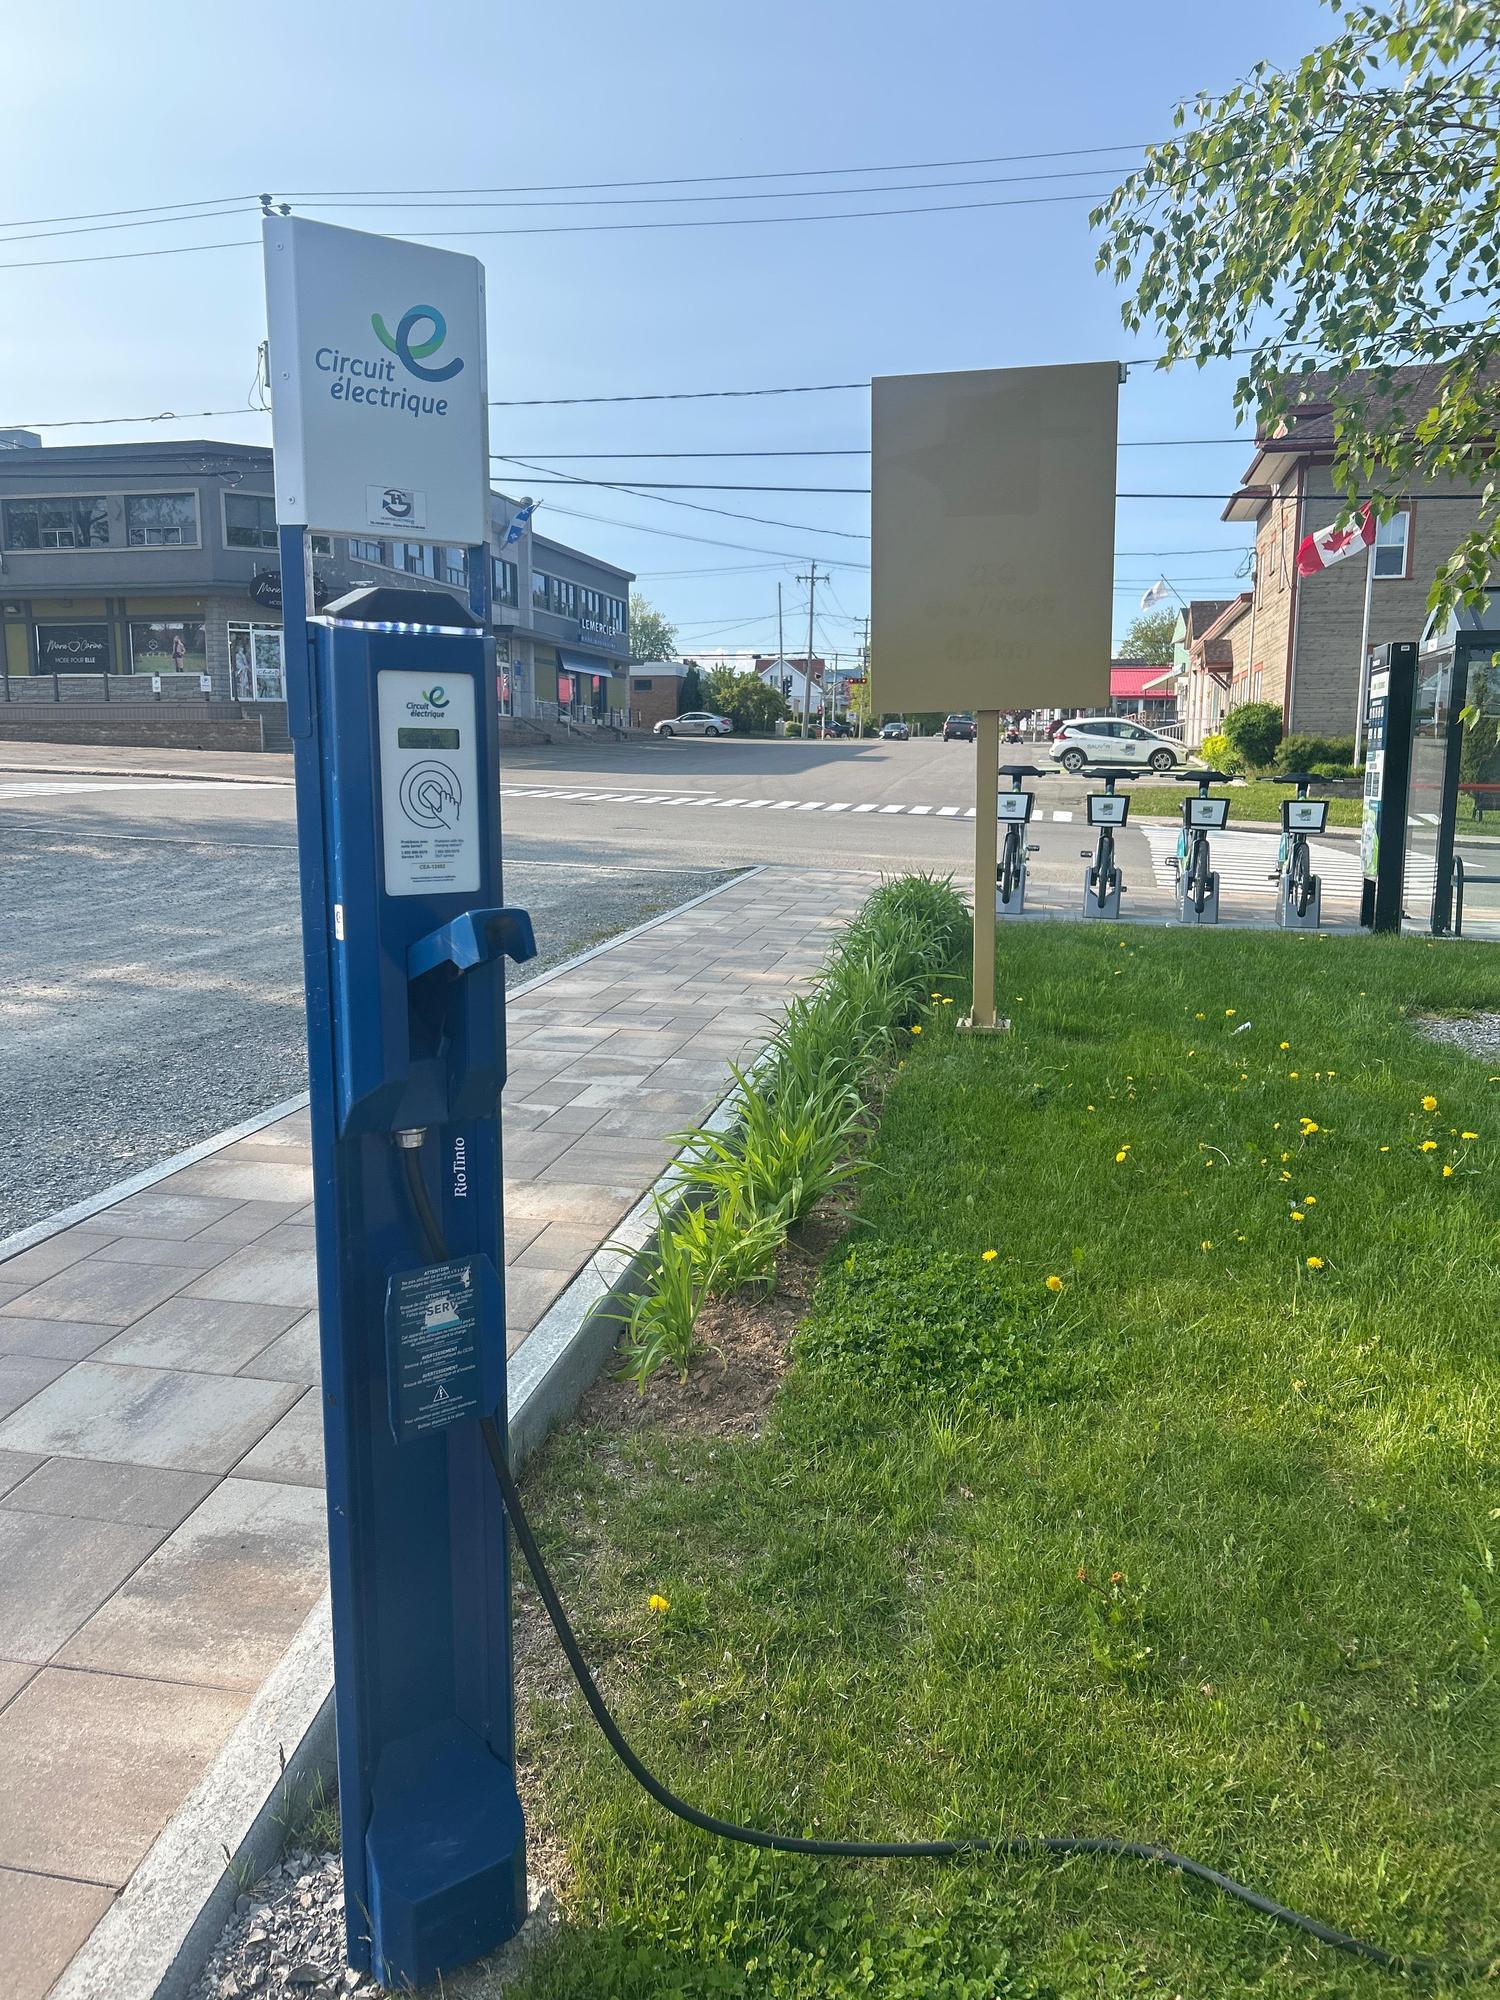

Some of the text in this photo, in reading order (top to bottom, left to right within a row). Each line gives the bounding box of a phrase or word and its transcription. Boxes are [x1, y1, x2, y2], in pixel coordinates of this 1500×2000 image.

[315, 348, 396, 382] Circuit
[330, 376, 448, 417] électrique
[581, 618, 616, 637] LEMERCIER
[406, 702, 429, 710] Circuit
[410, 710, 445, 719] électrique
[424, 1266, 449, 1276] ATTENTION
[425, 1289, 450, 1299] ATTENTION
